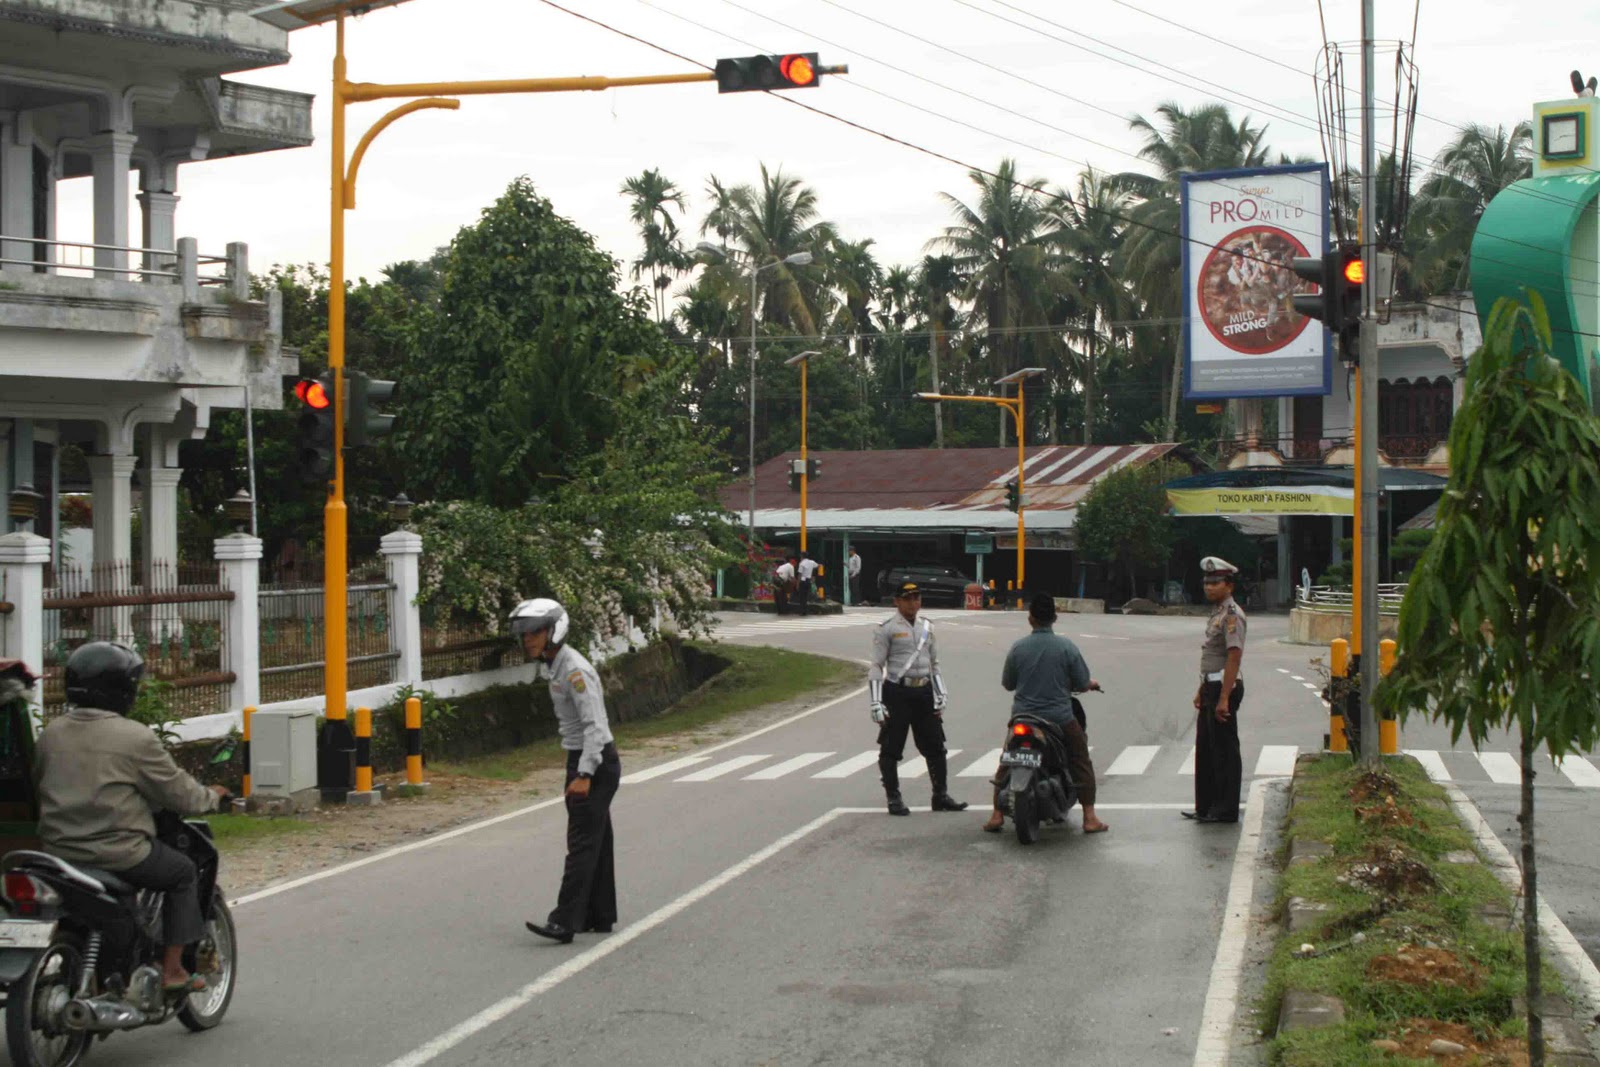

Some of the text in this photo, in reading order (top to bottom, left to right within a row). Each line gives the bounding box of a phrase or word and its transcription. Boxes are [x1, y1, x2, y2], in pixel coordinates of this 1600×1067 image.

[1210, 199, 1258, 223] PRO
[1260, 208, 1304, 220] MILD
[1229, 310, 1255, 324] MILD
[1223, 318, 1267, 336] STRONG
[1217, 493, 1311, 503] TOKO KARINA FASHION
